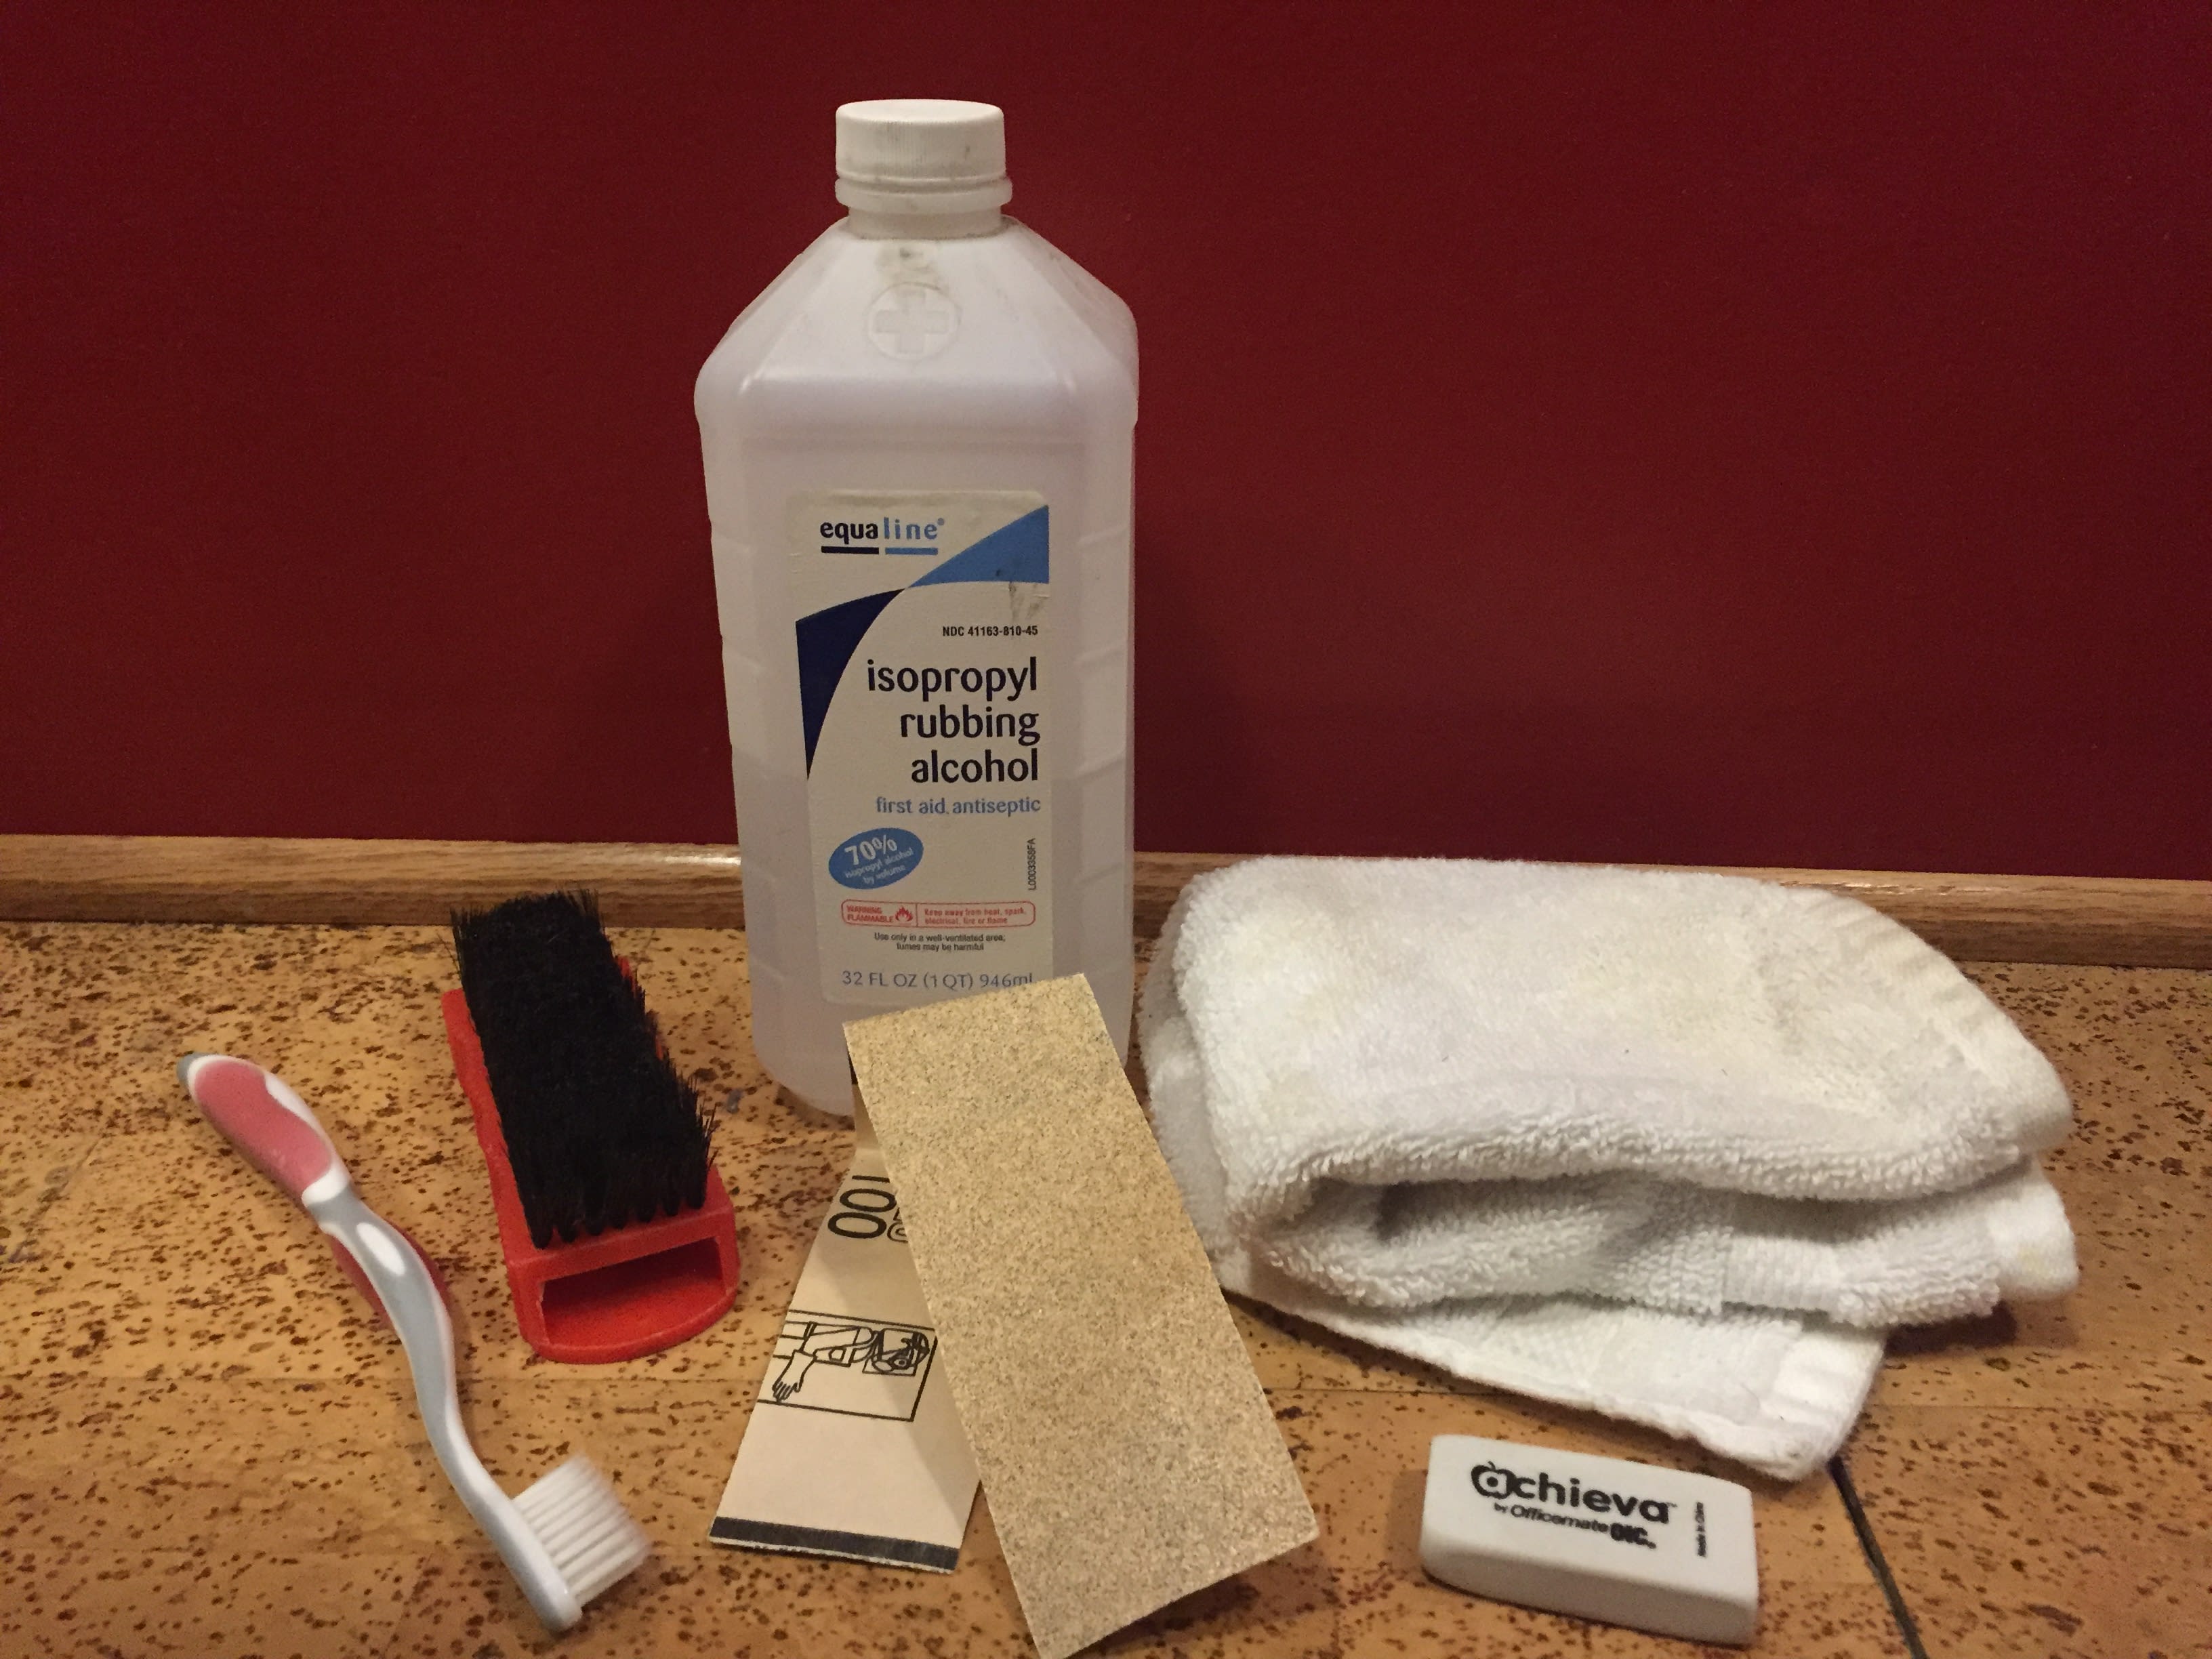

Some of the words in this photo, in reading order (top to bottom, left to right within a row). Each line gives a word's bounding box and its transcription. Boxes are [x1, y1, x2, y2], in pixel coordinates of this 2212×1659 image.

[942, 626, 964, 637] NDC
[967, 625, 1038, 637] 41163-810-45
[867, 655, 1038, 703] isopropyl
[900, 703, 1042, 747] rubbing
[911, 747, 1038, 783] alcohol
[876, 796, 913, 813] first
[952, 796, 1042, 818] antiseptic
[844, 834, 898, 865] 70%
[884, 846, 914, 865] alcohol
[875, 864, 906, 879] volume
[847, 914, 894, 923] FLAMMABLE
[924, 908, 943, 917] Keep
[945, 909, 964, 917] away
[987, 916, 1008, 924] flame
[874, 932, 890, 941] Use
[890, 933, 907, 943] only
[909, 933, 917, 941] in
[926, 934, 984, 942] well-ventilated
[897, 943, 921, 951] fumes
[922, 943, 940, 952] may
[941, 943, 952, 951] be
[953, 943, 985, 951] harmful
[842, 970, 863, 987] 32
[868, 972, 888, 987] FL
[893, 972, 918, 987] OZ
[942, 972, 974, 991] QT)
[1510, 1504, 1610, 1533] Officemate
